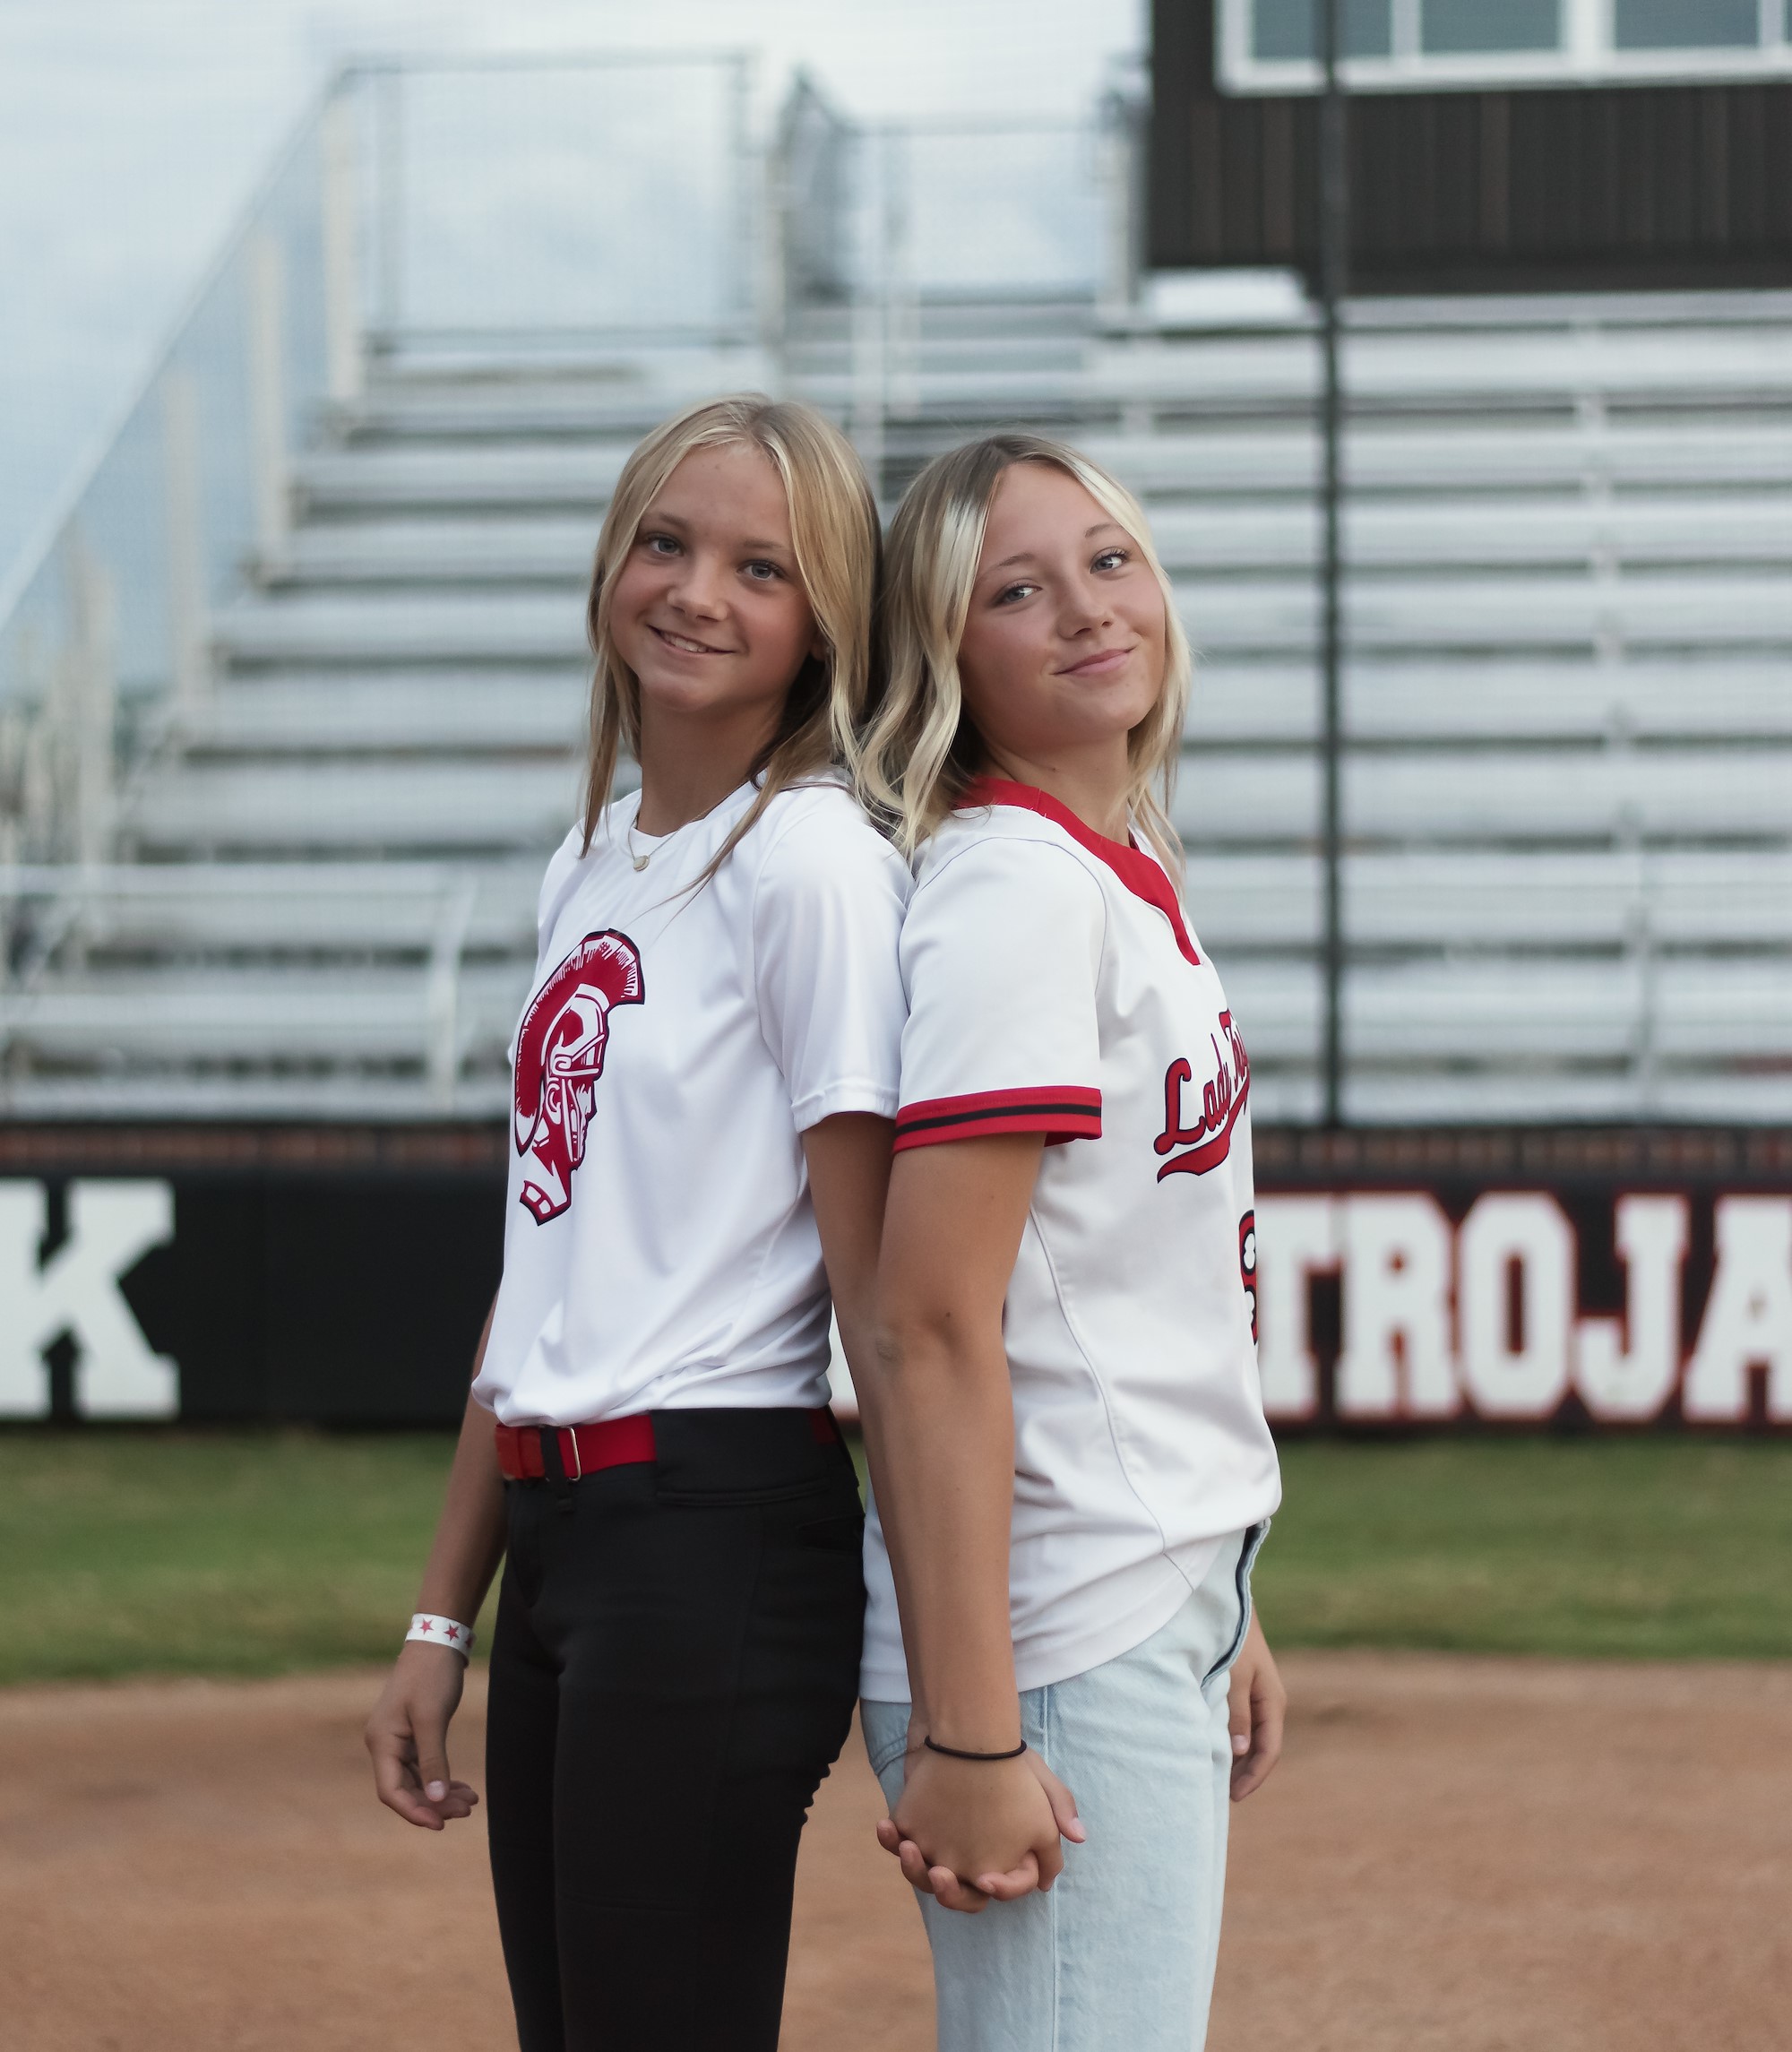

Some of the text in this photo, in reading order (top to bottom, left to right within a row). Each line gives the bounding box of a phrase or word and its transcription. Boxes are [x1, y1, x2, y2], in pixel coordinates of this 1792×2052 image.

[1154, 1032, 1232, 1156] Lady
[0, 1176, 180, 1421] K
[1253, 1188, 1792, 1423] TROJA
